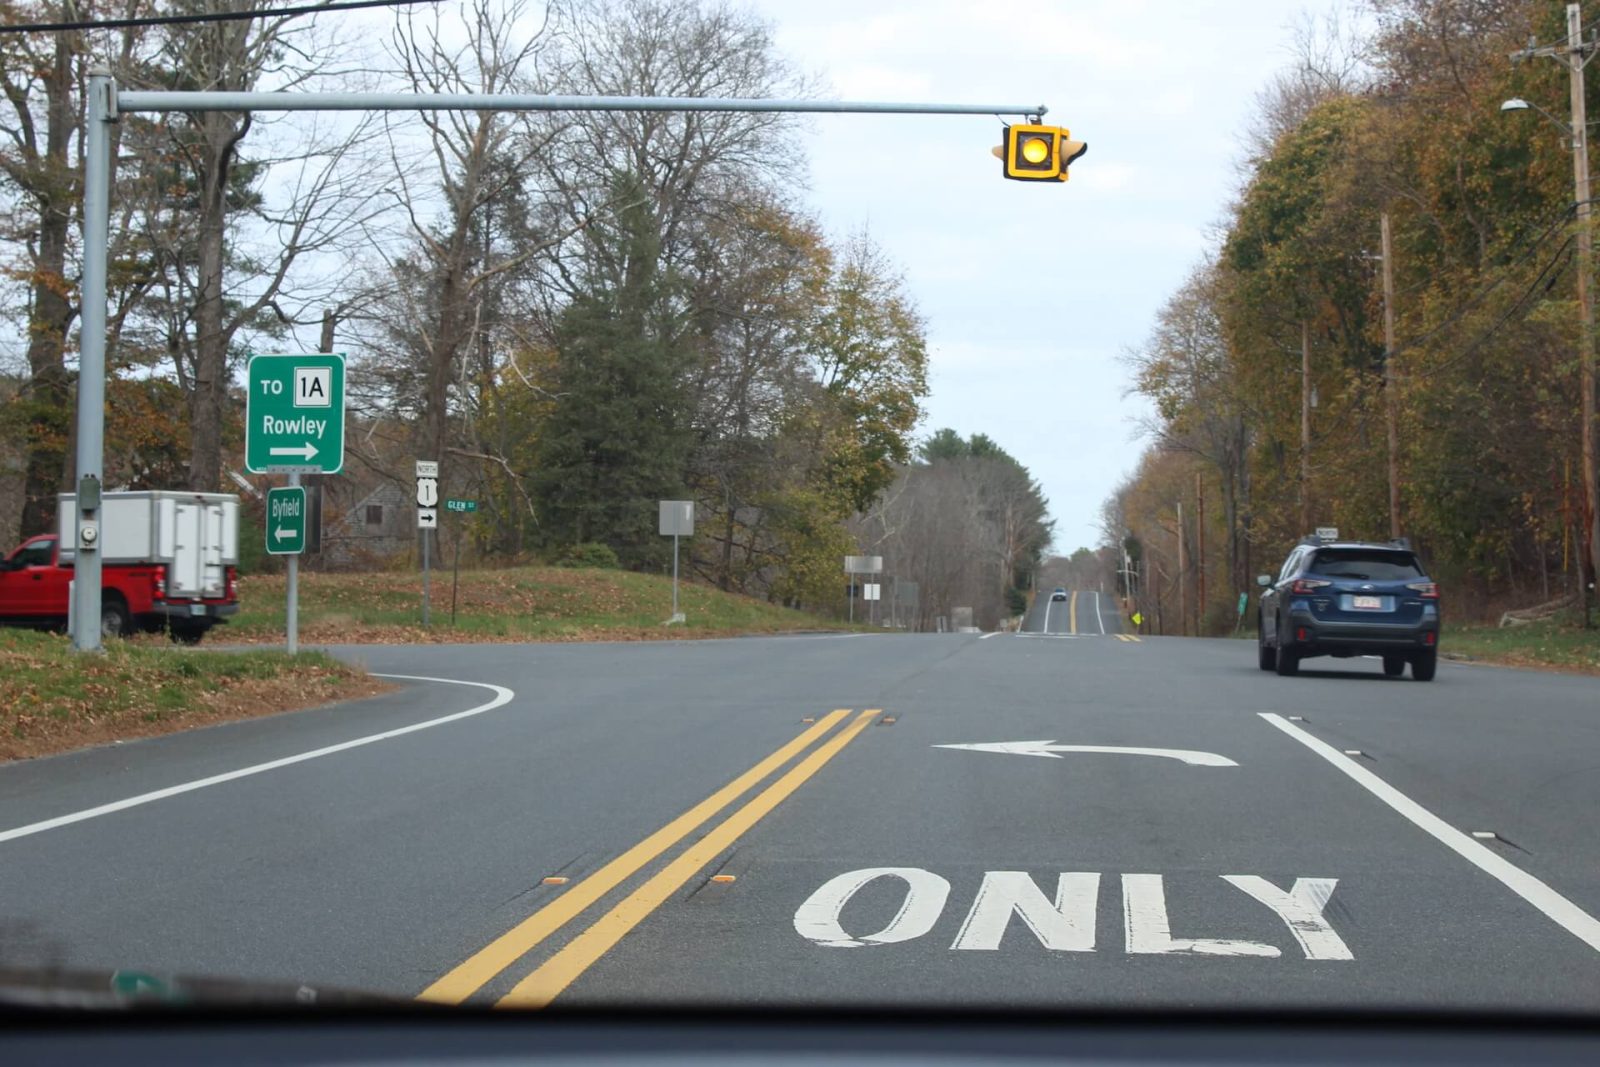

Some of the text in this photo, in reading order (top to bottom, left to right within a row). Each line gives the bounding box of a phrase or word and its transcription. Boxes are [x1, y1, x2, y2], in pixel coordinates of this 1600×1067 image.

[261, 377, 324, 397] TO 1A
[263, 415, 326, 439] Rowley
[272, 498, 300, 522] Byfield
[447, 500, 466, 510] GLEN
[793, 867, 1354, 961] ONLY
